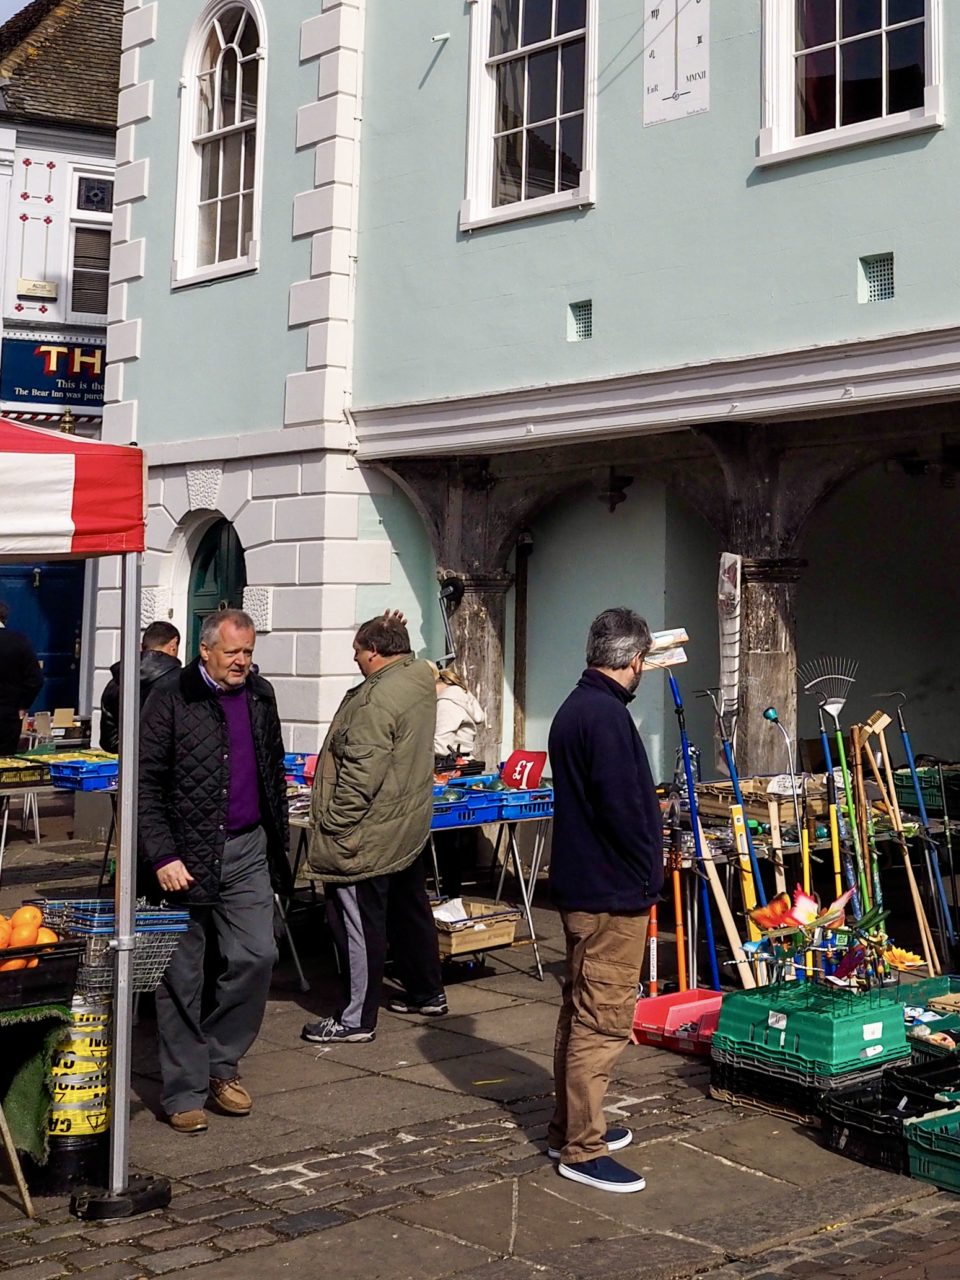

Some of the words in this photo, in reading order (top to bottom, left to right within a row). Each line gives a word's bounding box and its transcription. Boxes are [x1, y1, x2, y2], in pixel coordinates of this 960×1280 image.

[56, 379, 75, 389] This
[80, 381, 87, 389] is
[14, 387, 29, 396] The
[32, 388, 49, 397] Bear
[51, 390, 64, 398] Inn
[512, 759, 534, 789] £1
